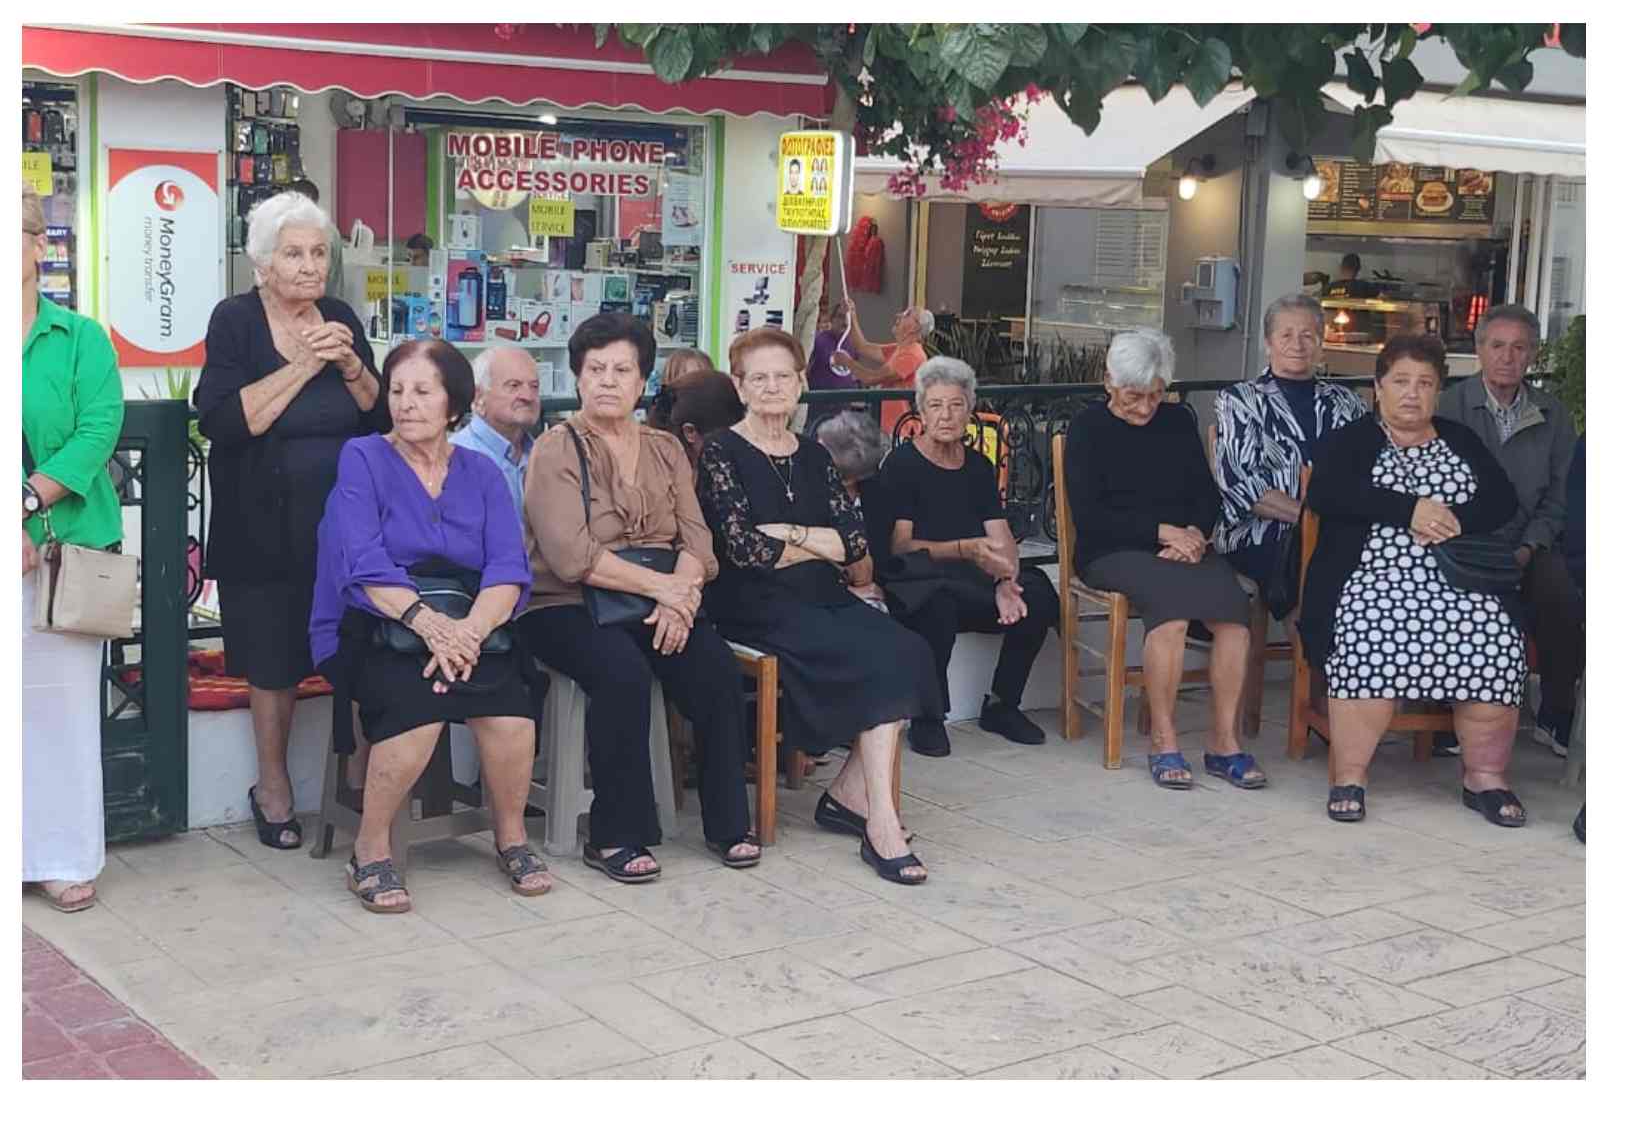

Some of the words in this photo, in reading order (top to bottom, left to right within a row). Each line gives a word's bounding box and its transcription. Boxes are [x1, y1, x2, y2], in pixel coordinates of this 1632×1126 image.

[448, 134, 557, 160] MOBILE
[572, 140, 664, 164] PHONE
[457, 169, 649, 195] ACCESSORIES
[531, 204, 565, 215] MOBILE
[142, 216, 153, 255] money
[531, 222, 565, 234] SERVICE
[156, 217, 175, 338] MoneyGram
[731, 263, 785, 275] SERVICE
